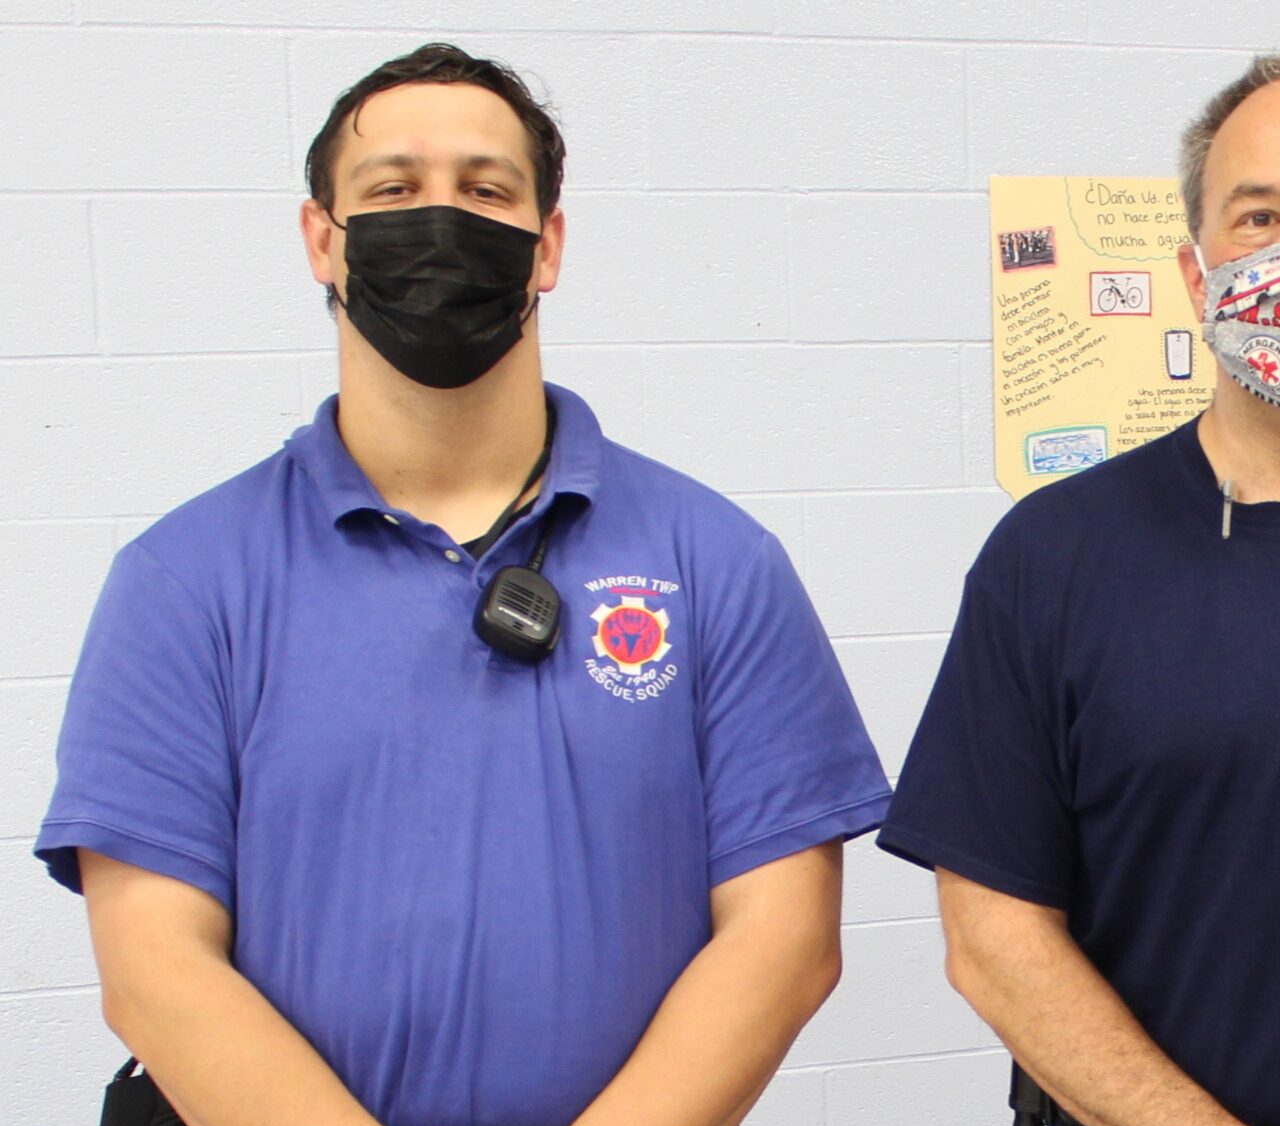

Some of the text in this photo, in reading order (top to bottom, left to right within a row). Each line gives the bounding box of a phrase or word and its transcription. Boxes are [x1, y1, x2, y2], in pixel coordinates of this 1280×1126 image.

[1097, 213, 1115, 225] no
[1123, 211, 1150, 224] hace
[1100, 235, 1147, 248] mucha
[997, 280, 1051, 307] Una persona
[1035, 327, 1065, 345] Montar
[584, 576, 679, 594] WARREN TWP
[584, 659, 678, 703] RESCUE SQUAD
